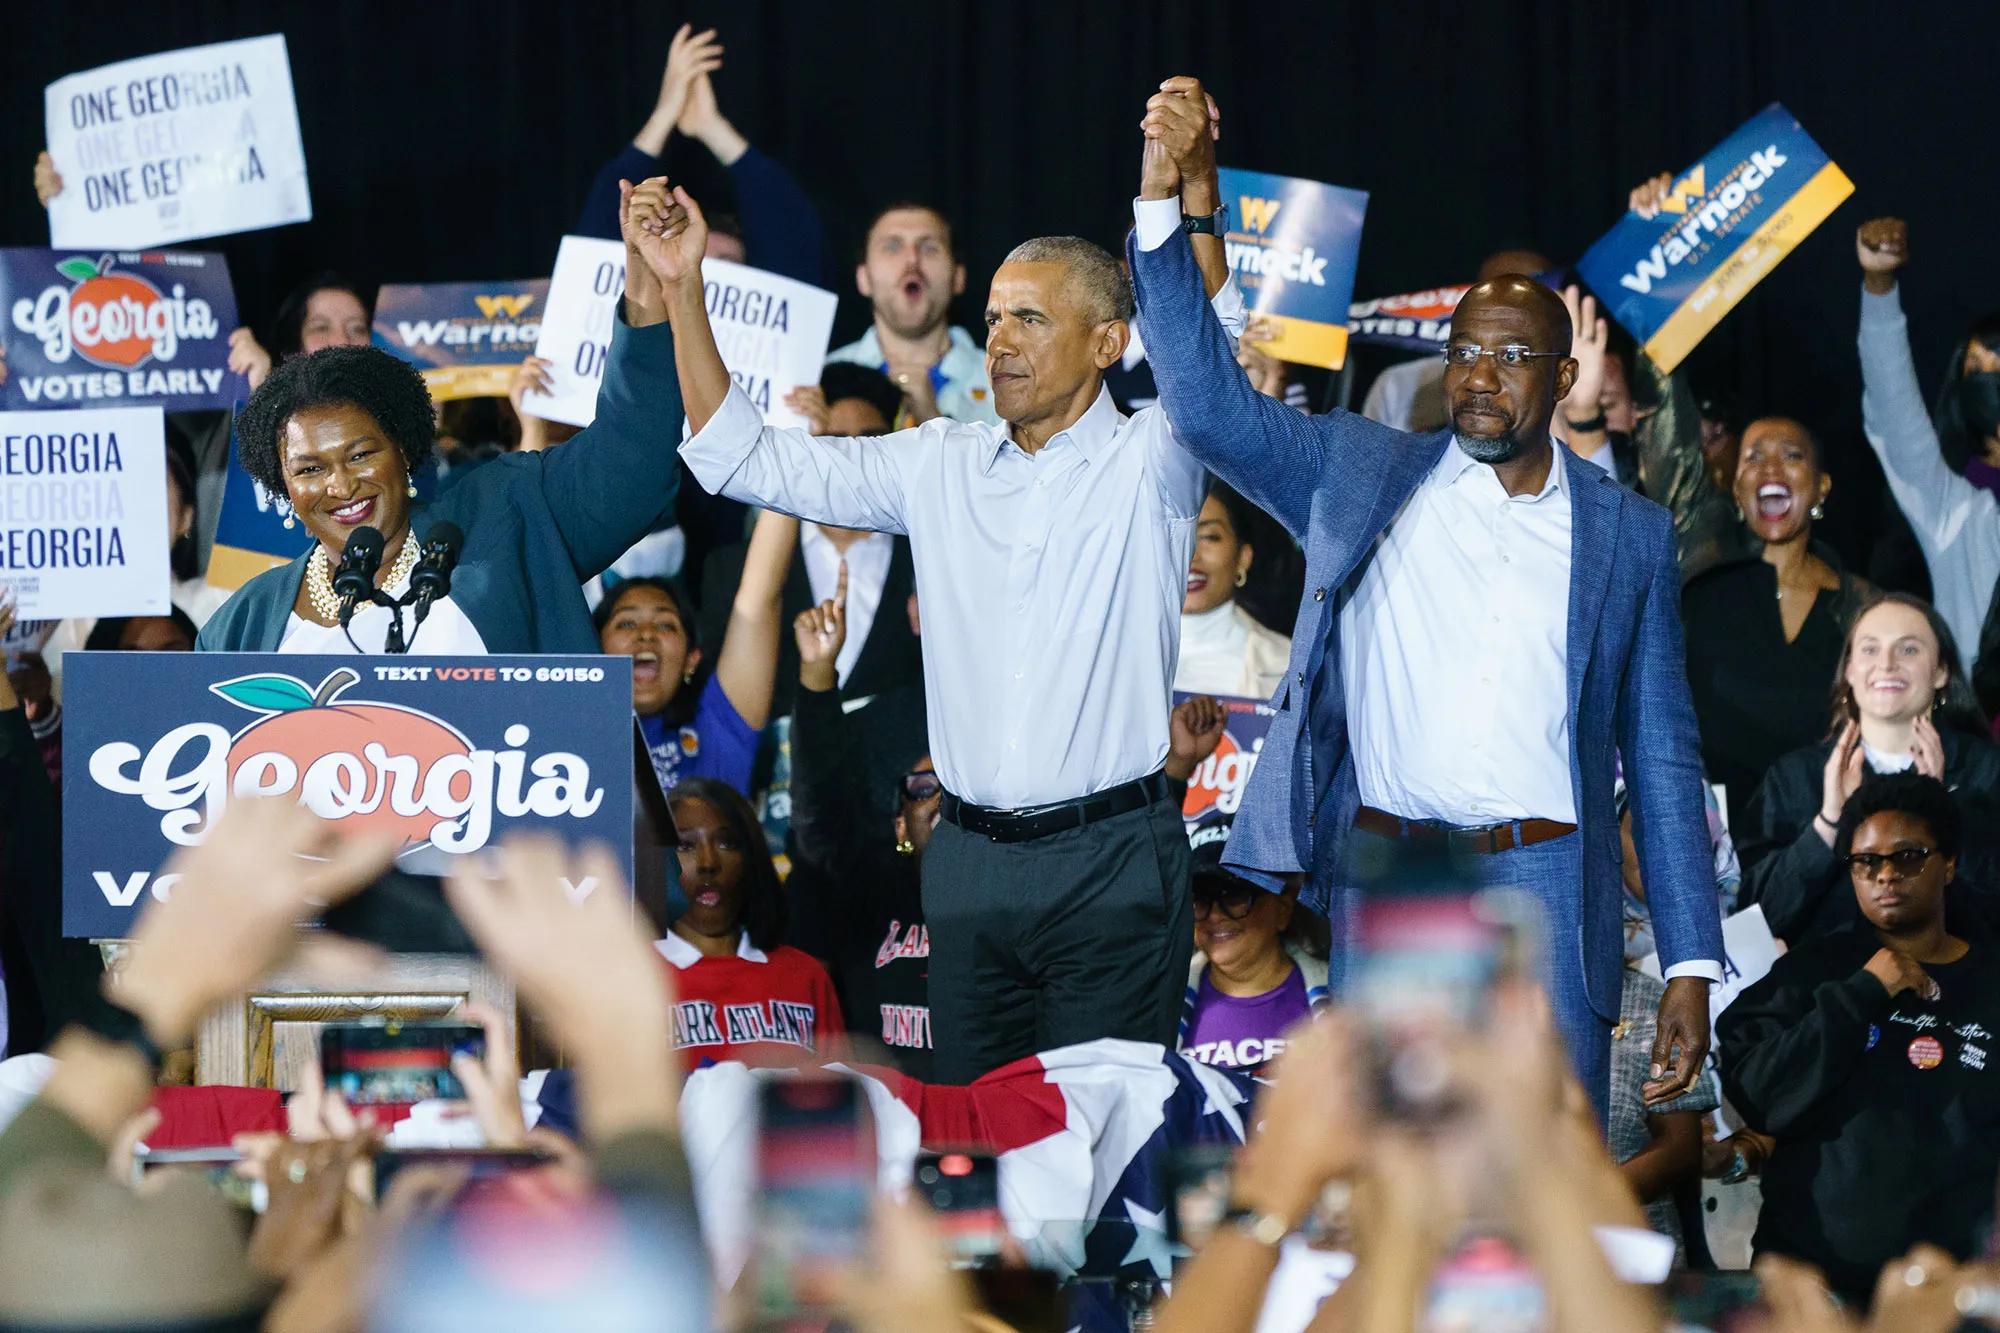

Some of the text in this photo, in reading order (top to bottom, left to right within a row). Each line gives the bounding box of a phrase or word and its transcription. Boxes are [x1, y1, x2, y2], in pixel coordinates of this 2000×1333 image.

[71, 86, 122, 131] ONE
[84, 167, 138, 213] ONE
[1620, 144, 1788, 295] Warnock
[12, 284, 219, 363] Georgia
[19, 368, 224, 401] VOTES EARLY
[0, 432, 123, 475] EORGIA
[0, 479, 125, 523] EORGIA
[373, 666, 605, 682] TEXT VOTE TO 60150
[88, 722, 605, 853] Georgia
